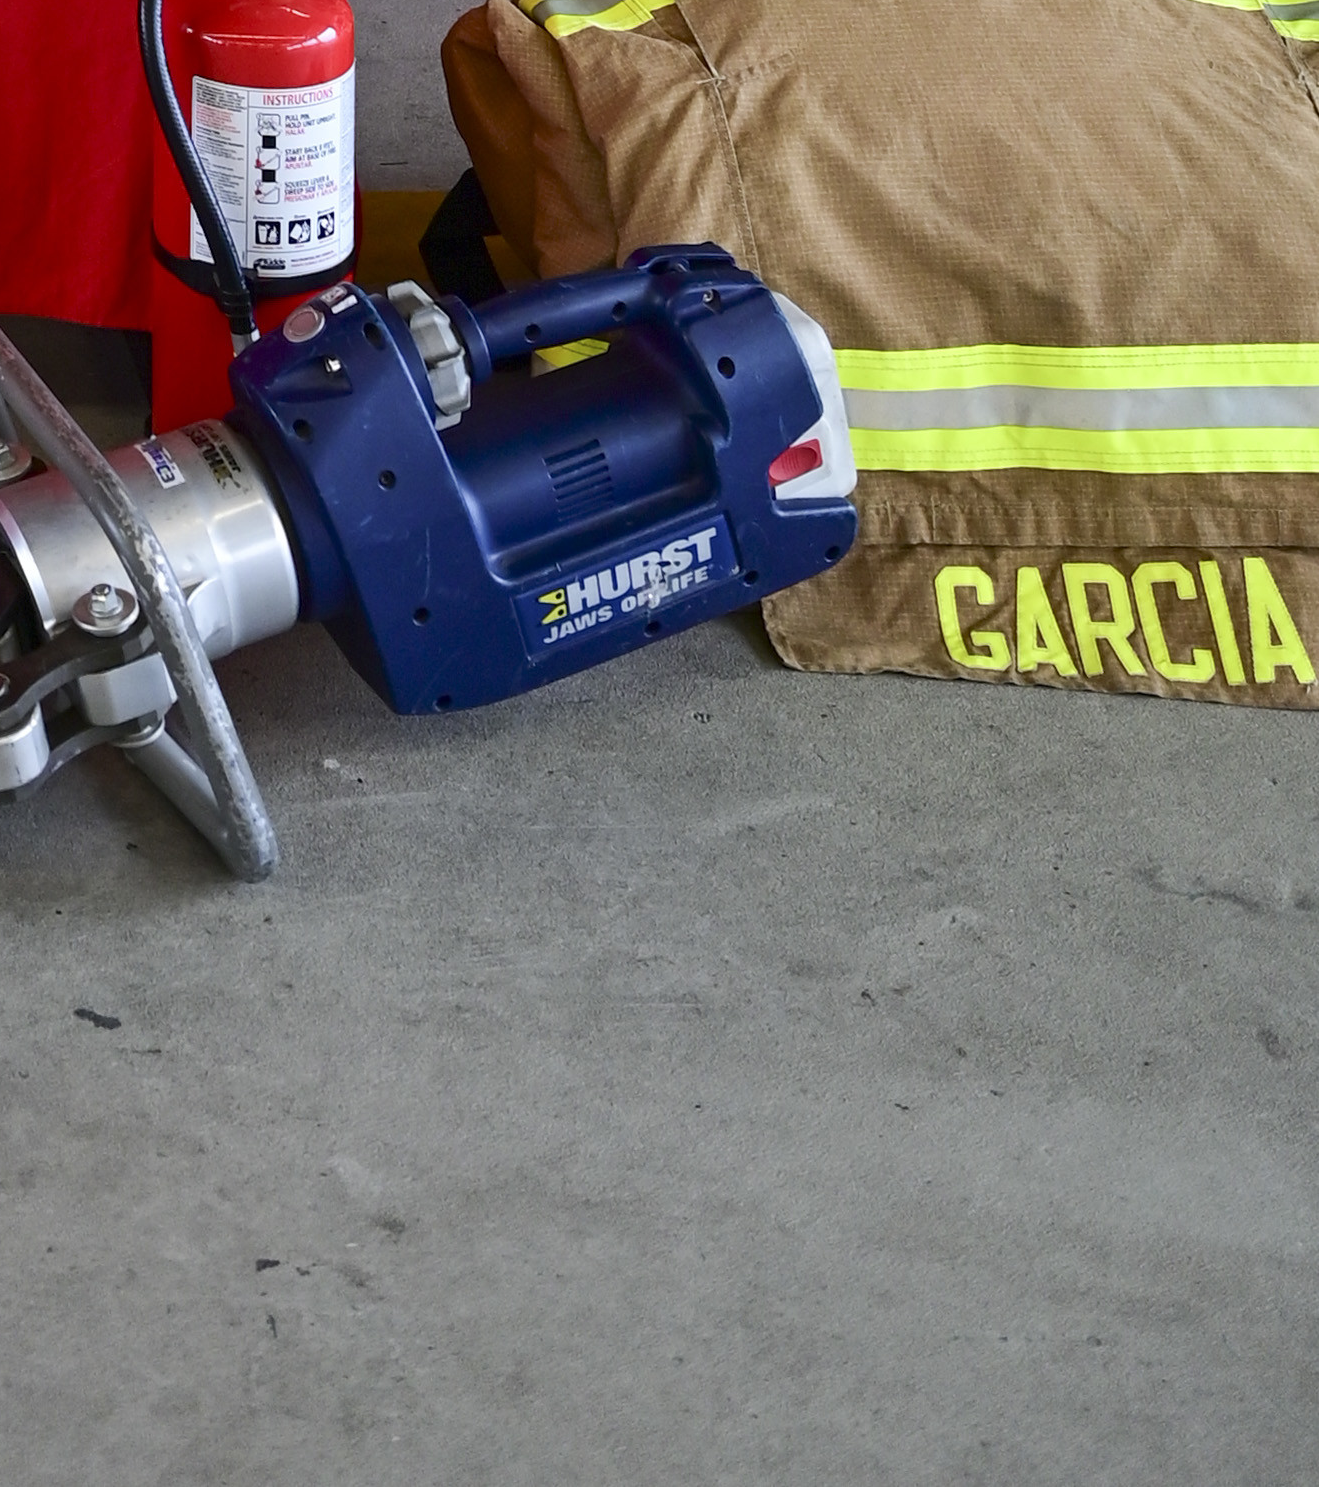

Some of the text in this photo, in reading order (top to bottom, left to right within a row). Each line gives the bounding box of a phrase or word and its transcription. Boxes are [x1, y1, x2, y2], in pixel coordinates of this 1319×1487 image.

[263, 87, 333, 106] INSTRUCTIONS
[566, 526, 717, 615] HURST
[543, 605, 614, 644] JAWS
[934, 556, 1319, 686] GARCIA
